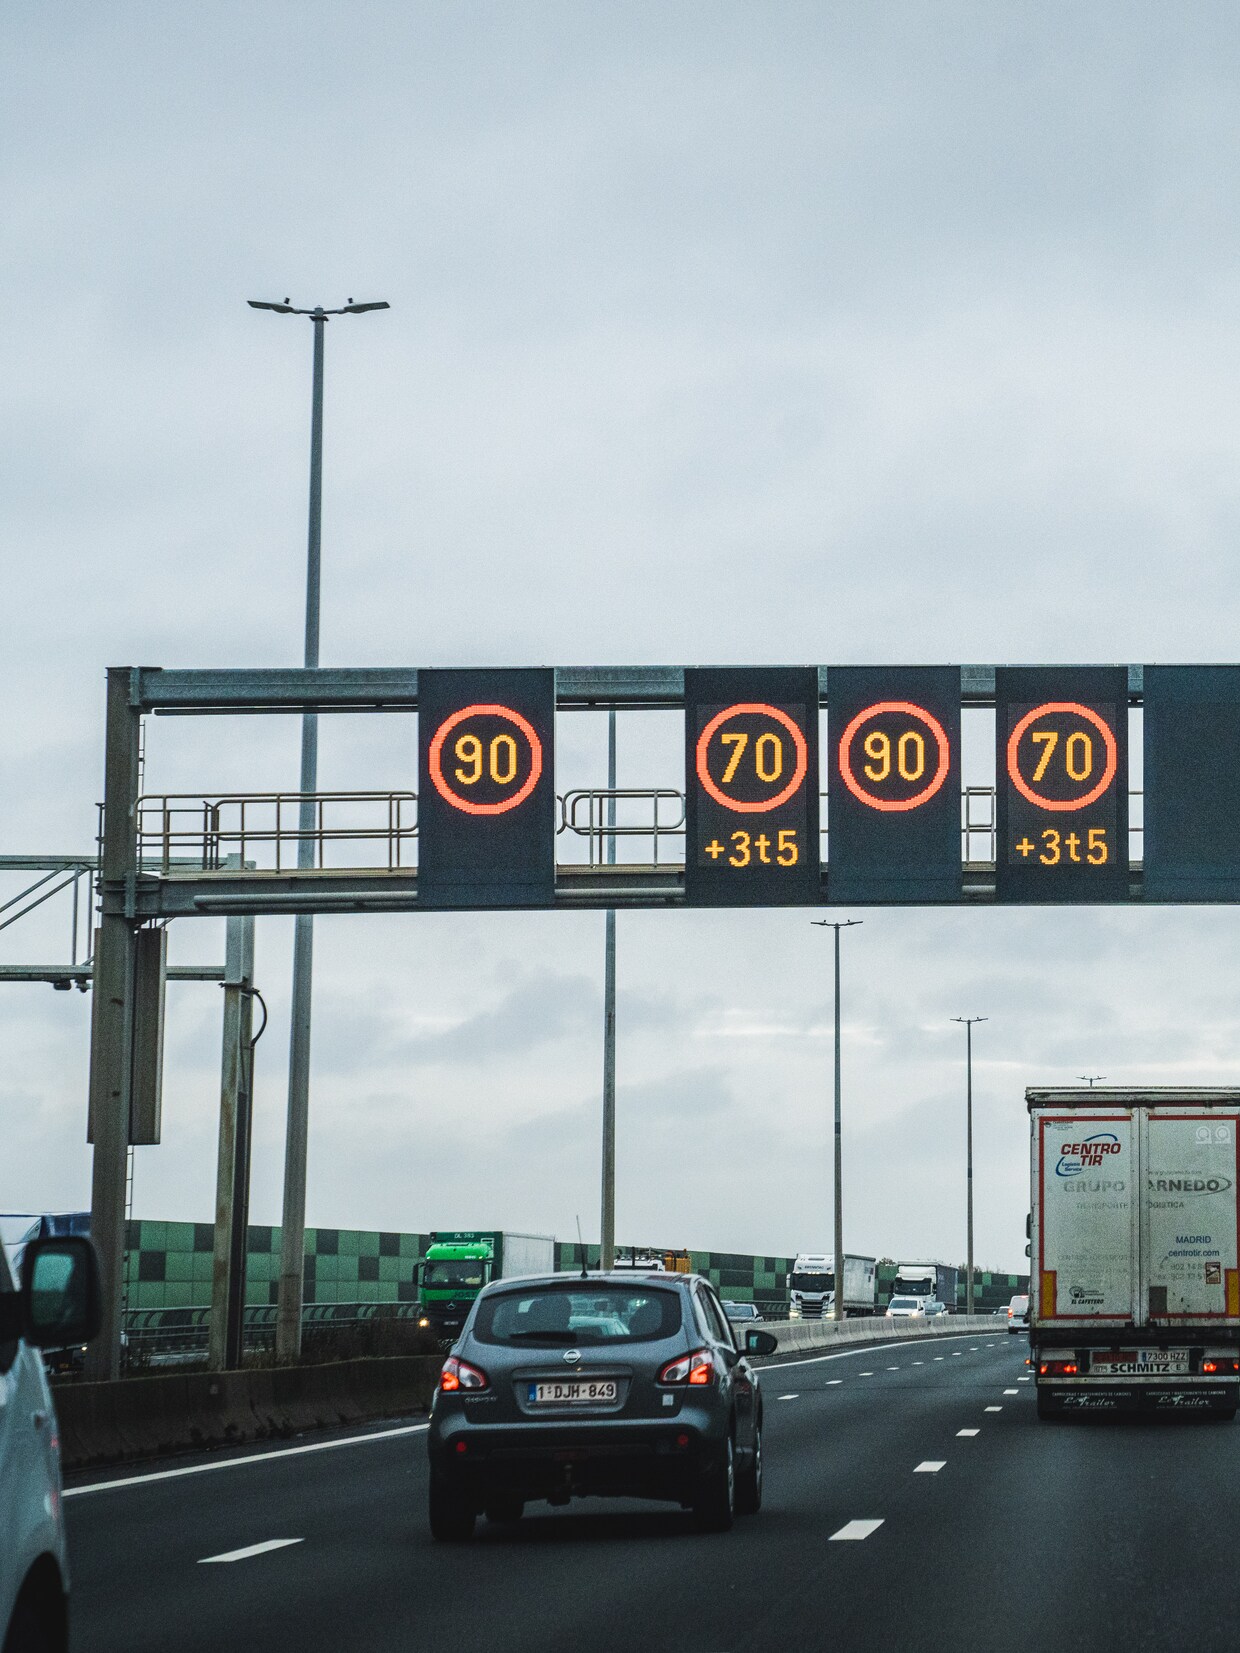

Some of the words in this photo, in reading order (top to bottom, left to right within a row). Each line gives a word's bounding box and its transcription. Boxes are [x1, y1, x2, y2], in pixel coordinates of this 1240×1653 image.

[454, 733, 517, 785] 90
[720, 733, 784, 783] 70
[864, 731, 926, 782] 90
[1031, 731, 1093, 782] 70
[704, 829, 799, 867] +3t5
[1015, 828, 1108, 865] +3t5
[1061, 1143, 1121, 1155] CENTRO
[1080, 1154, 1103, 1167] TIR
[1063, 1181, 1125, 1193] GRUPO
[1175, 1235, 1212, 1244] MADRID
[1168, 1248, 1220, 1258] centrotir.com
[1110, 1363, 1170, 1373] SCHMITZ
